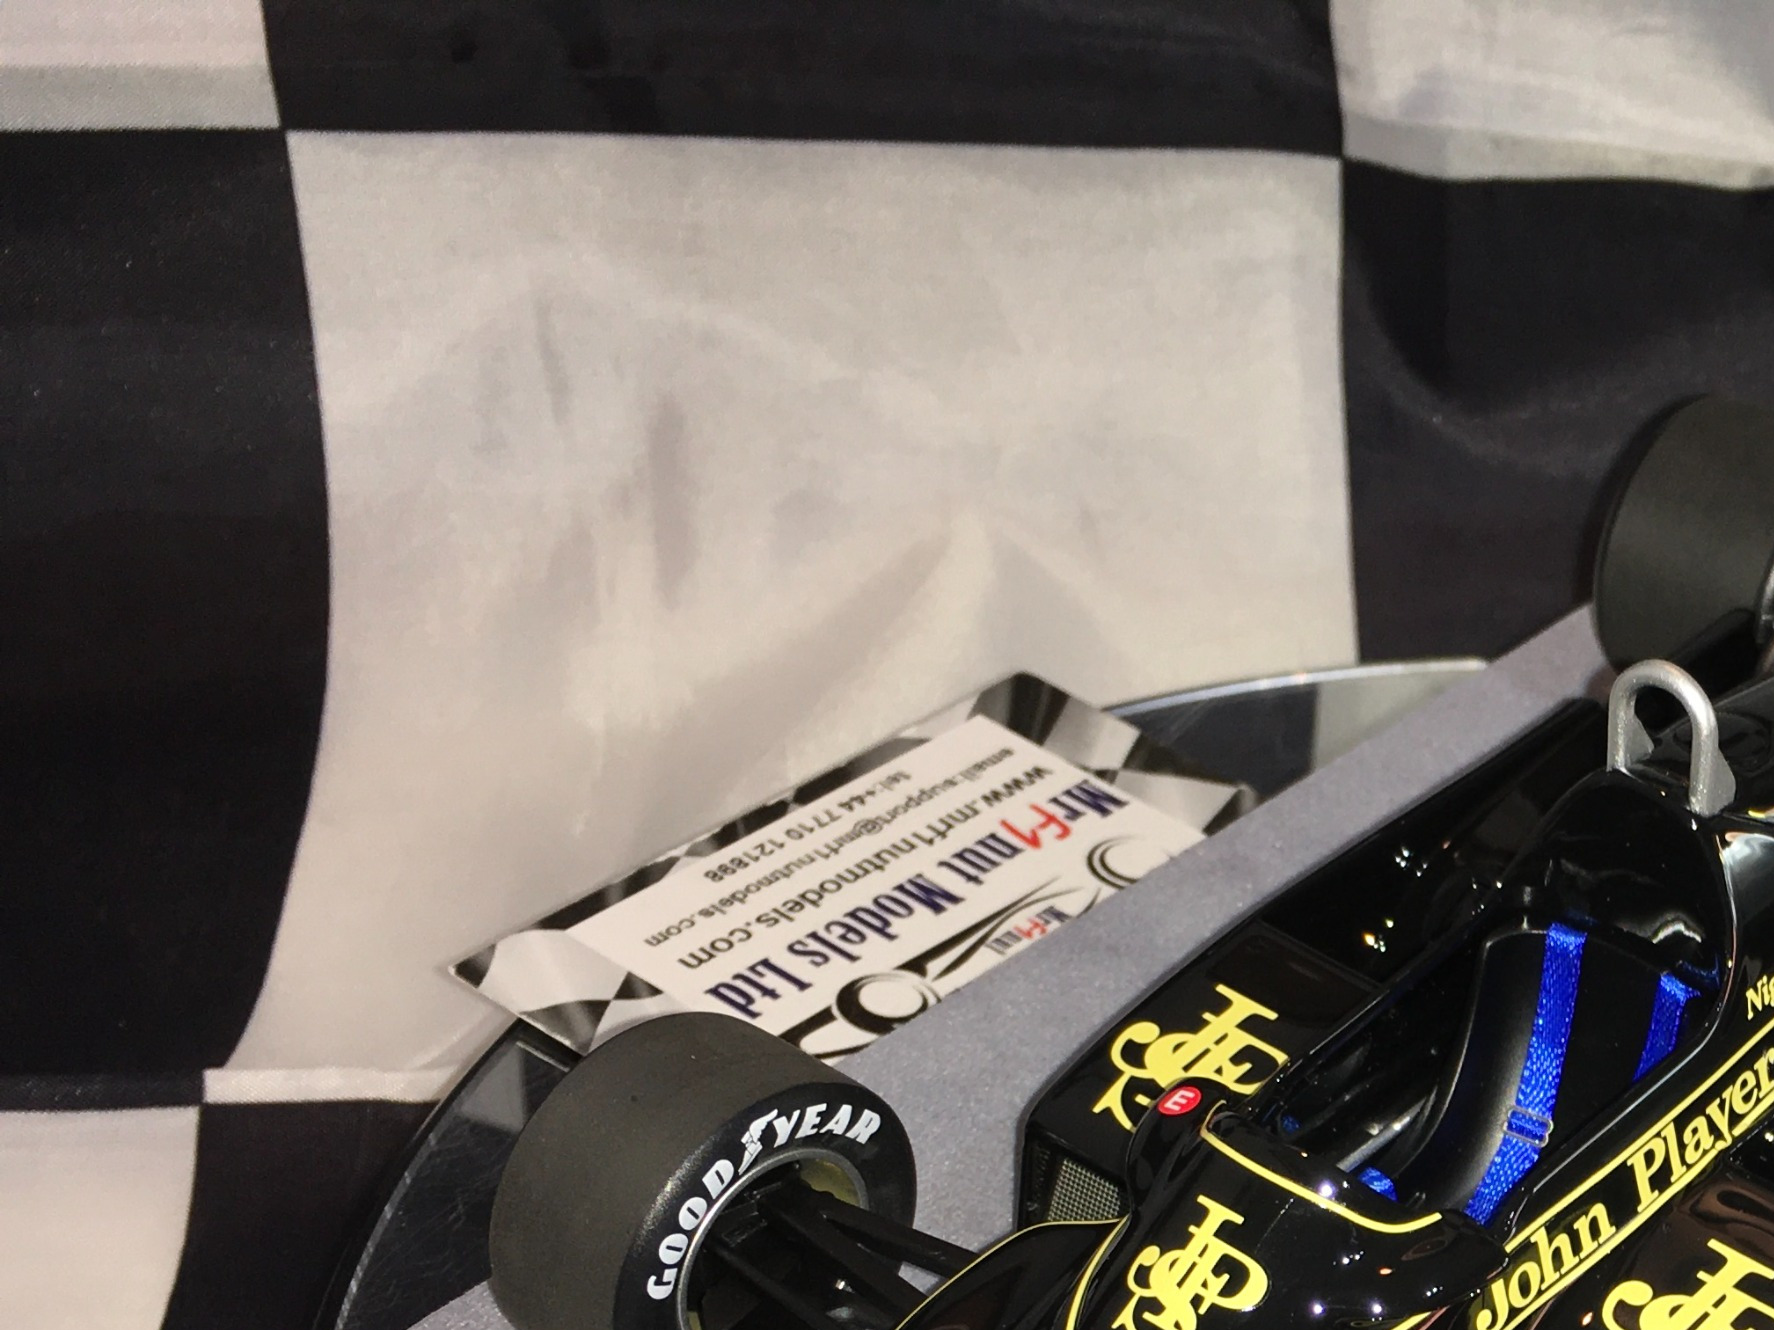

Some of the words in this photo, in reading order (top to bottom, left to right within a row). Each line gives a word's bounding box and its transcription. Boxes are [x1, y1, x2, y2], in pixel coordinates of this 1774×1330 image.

[677, 766, 1054, 970] www.mrf1nutmodels.com
[787, 873, 965, 968] Models
[704, 957, 813, 1020] Ltd
